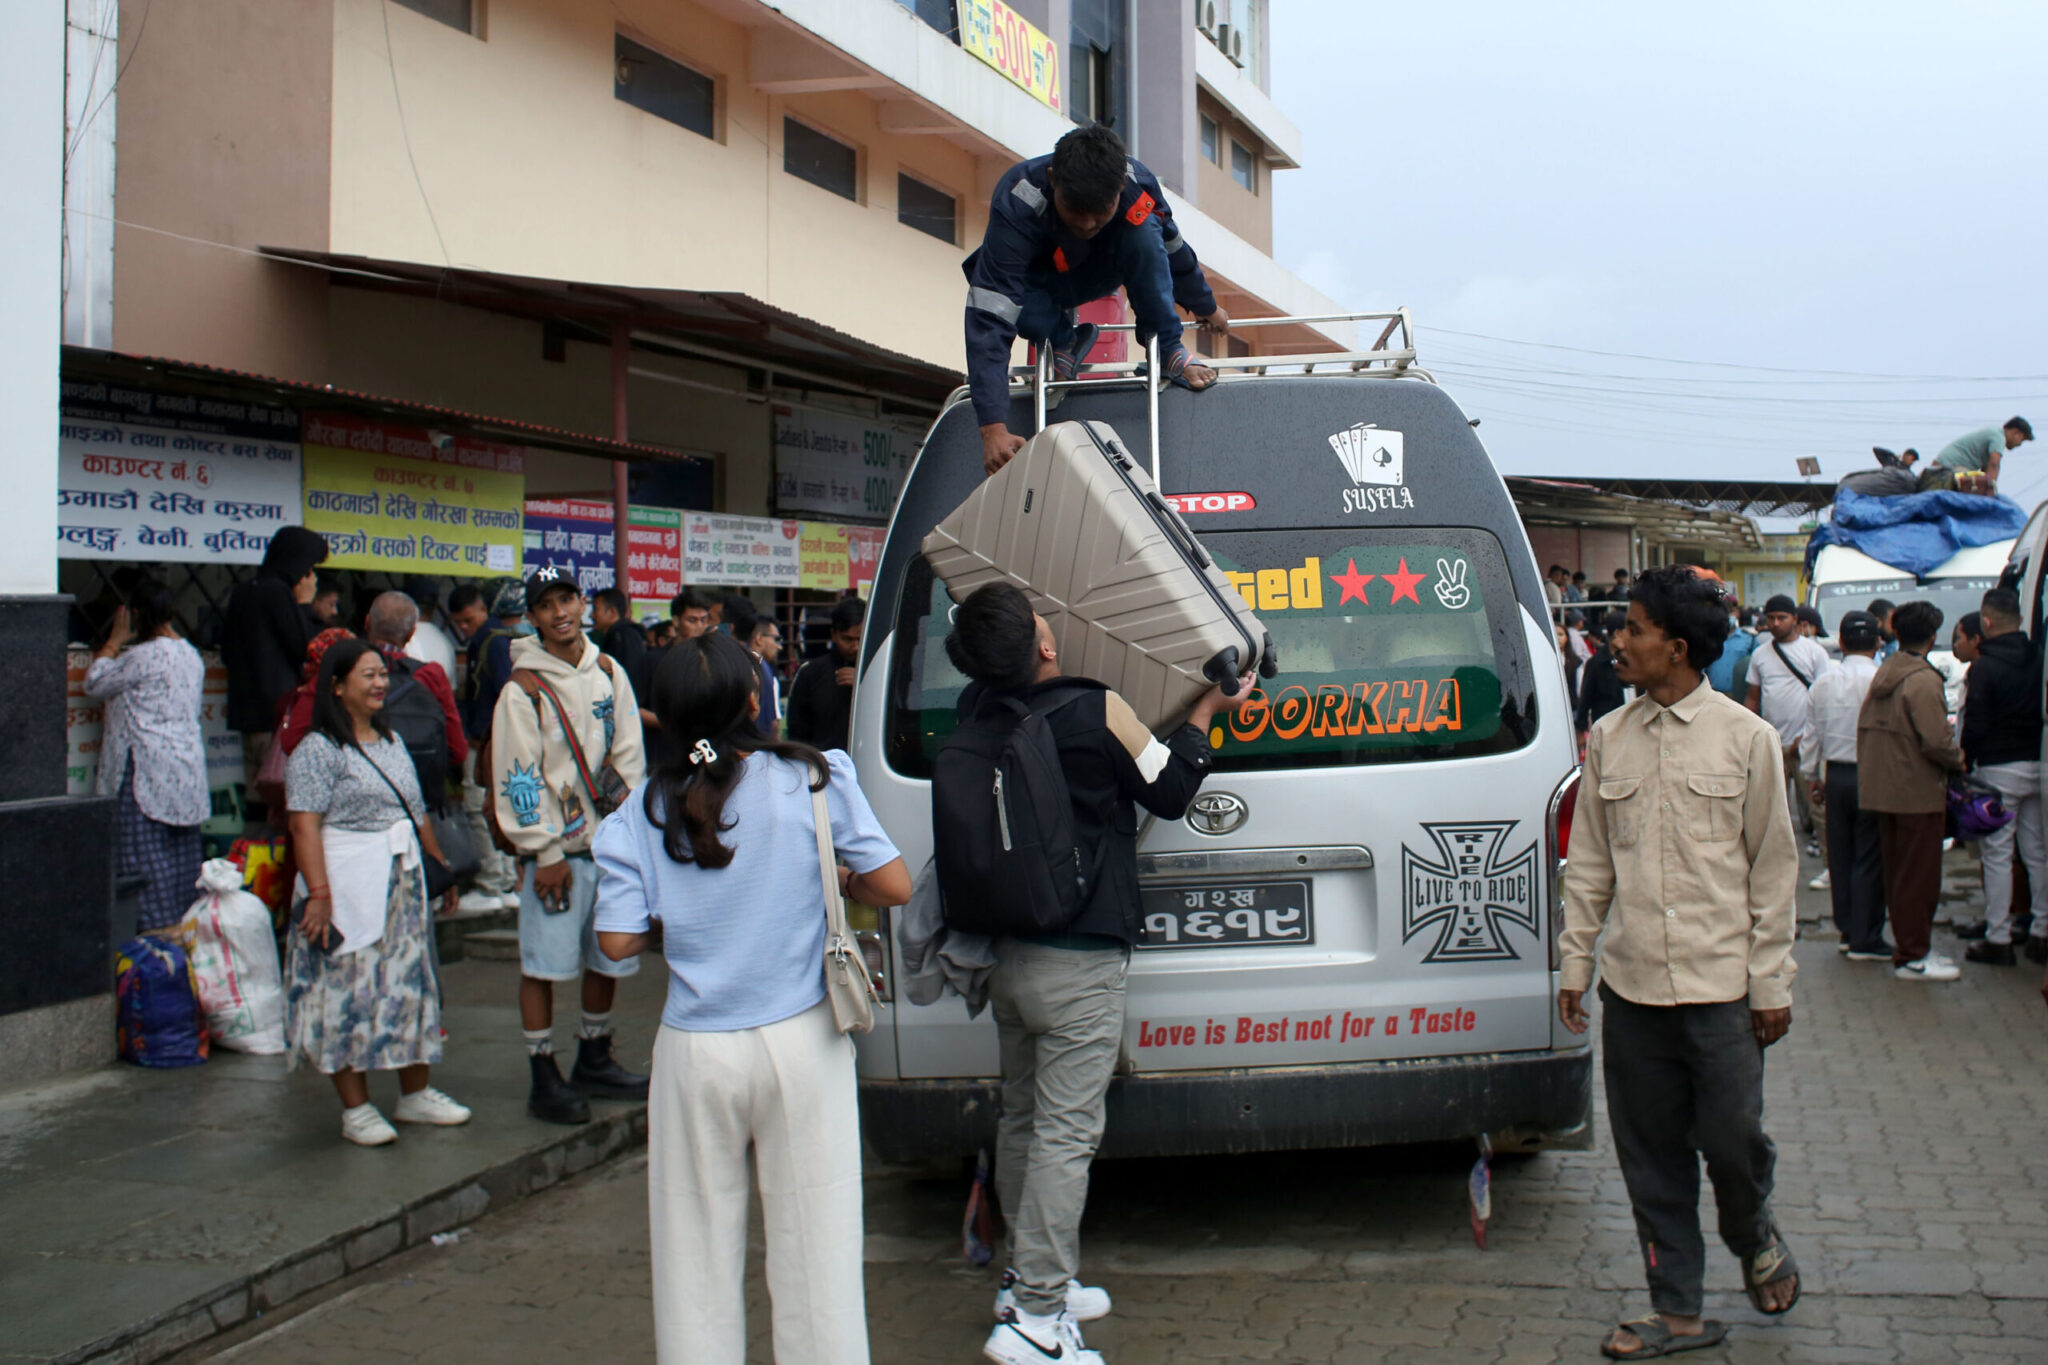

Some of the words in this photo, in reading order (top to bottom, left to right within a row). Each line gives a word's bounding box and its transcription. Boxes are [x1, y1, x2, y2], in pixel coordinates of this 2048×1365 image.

[993, 0, 1031, 88] 500
[1045, 41, 1059, 109] 2
[131, 431, 165, 448] तथा
[233, 443, 258, 458] बस
[82, 454, 164, 481] काउण्टर
[197, 464, 209, 485] ६
[374, 467, 437, 490] काउण्टर
[58, 488, 139, 510] ठमाडौ
[150, 491, 206, 515] देखि
[386, 493, 416, 520] देखि
[422, 497, 467, 525] गोरखा
[472, 507, 520, 530] सम्मको
[1166, 494, 1247, 513] STOP
[1342, 486, 1415, 513] SUSELA
[204, 528, 271, 553] बुर्तिवा
[318, 529, 366, 555] इक्रो
[372, 534, 415, 559] बसको
[422, 536, 460, 562] टिकट
[465, 542, 488, 567] पाई
[1228, 678, 1462, 742] GORKHA
[1454, 833, 1484, 875] RIDE
[1184, 890, 1206, 908] ग
[1211, 890, 1227, 907] २
[1229, 888, 1256, 907] ख
[1415, 875, 1453, 908] LIVE
[1459, 879, 1481, 902] TO
[1488, 873, 1526, 904] RIDE
[1455, 906, 1486, 947] LIVE
[1138, 1020, 1196, 1047] Love
[1204, 1018, 1226, 1045] is
[1234, 1016, 1288, 1044] Best
[1294, 1014, 1332, 1042] not
[1340, 1011, 1375, 1043] for
[1385, 1014, 1399, 1036] a
[1409, 1007, 1476, 1034] Taste
